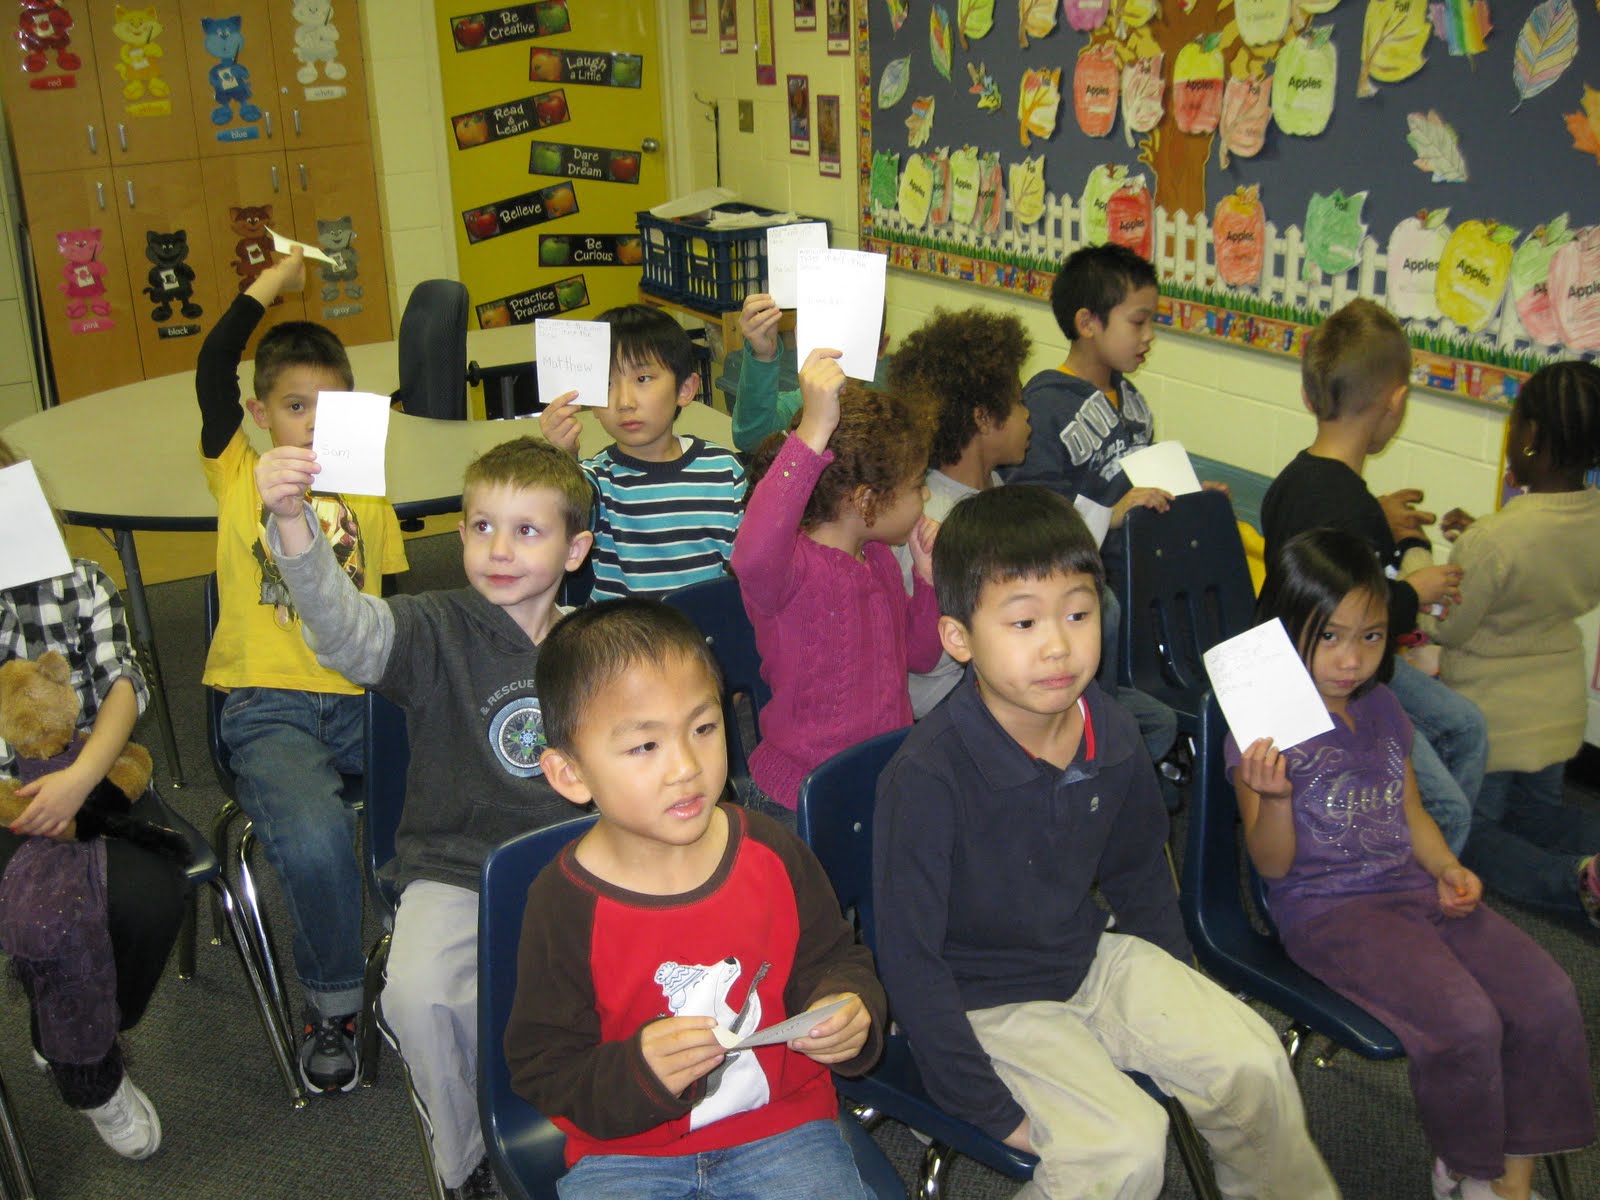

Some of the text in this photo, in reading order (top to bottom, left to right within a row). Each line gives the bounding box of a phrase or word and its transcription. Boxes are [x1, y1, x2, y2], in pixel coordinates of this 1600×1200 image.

[501, 11, 519, 24] Be
[489, 23, 535, 39] Creative
[566, 57, 607, 72] Laugh
[47, 77, 62, 87] red
[570, 70, 602, 80] a Little
[1086, 84, 1109, 96] Apples
[1185, 79, 1214, 92] Apples
[1288, 76, 1322, 91] Apples
[494, 104, 524, 120] Read
[495, 119, 529, 135] Learn
[507, 116, 515, 125] &
[231, 130, 248, 139] blue
[573, 148, 600, 161] Dare
[568, 163, 602, 177] Dream
[500, 203, 542, 223] Believe
[1120, 217, 1145, 232] Apples
[585, 237, 602, 250] Be
[1226, 231, 1254, 244] Apples
[574, 250, 613, 262] Curious
[1403, 258, 1440, 274] Apples
[1456, 259, 1491, 287] Apples
[1568, 281, 1600, 299] Apple
[510, 291, 555, 310] Practice
[514, 302, 556, 320] Practice
[83, 320, 100, 332] pink
[167, 326, 188, 336] black
[542, 354, 593, 373] Matthew
[487, 680, 535, 706] RESCUE
